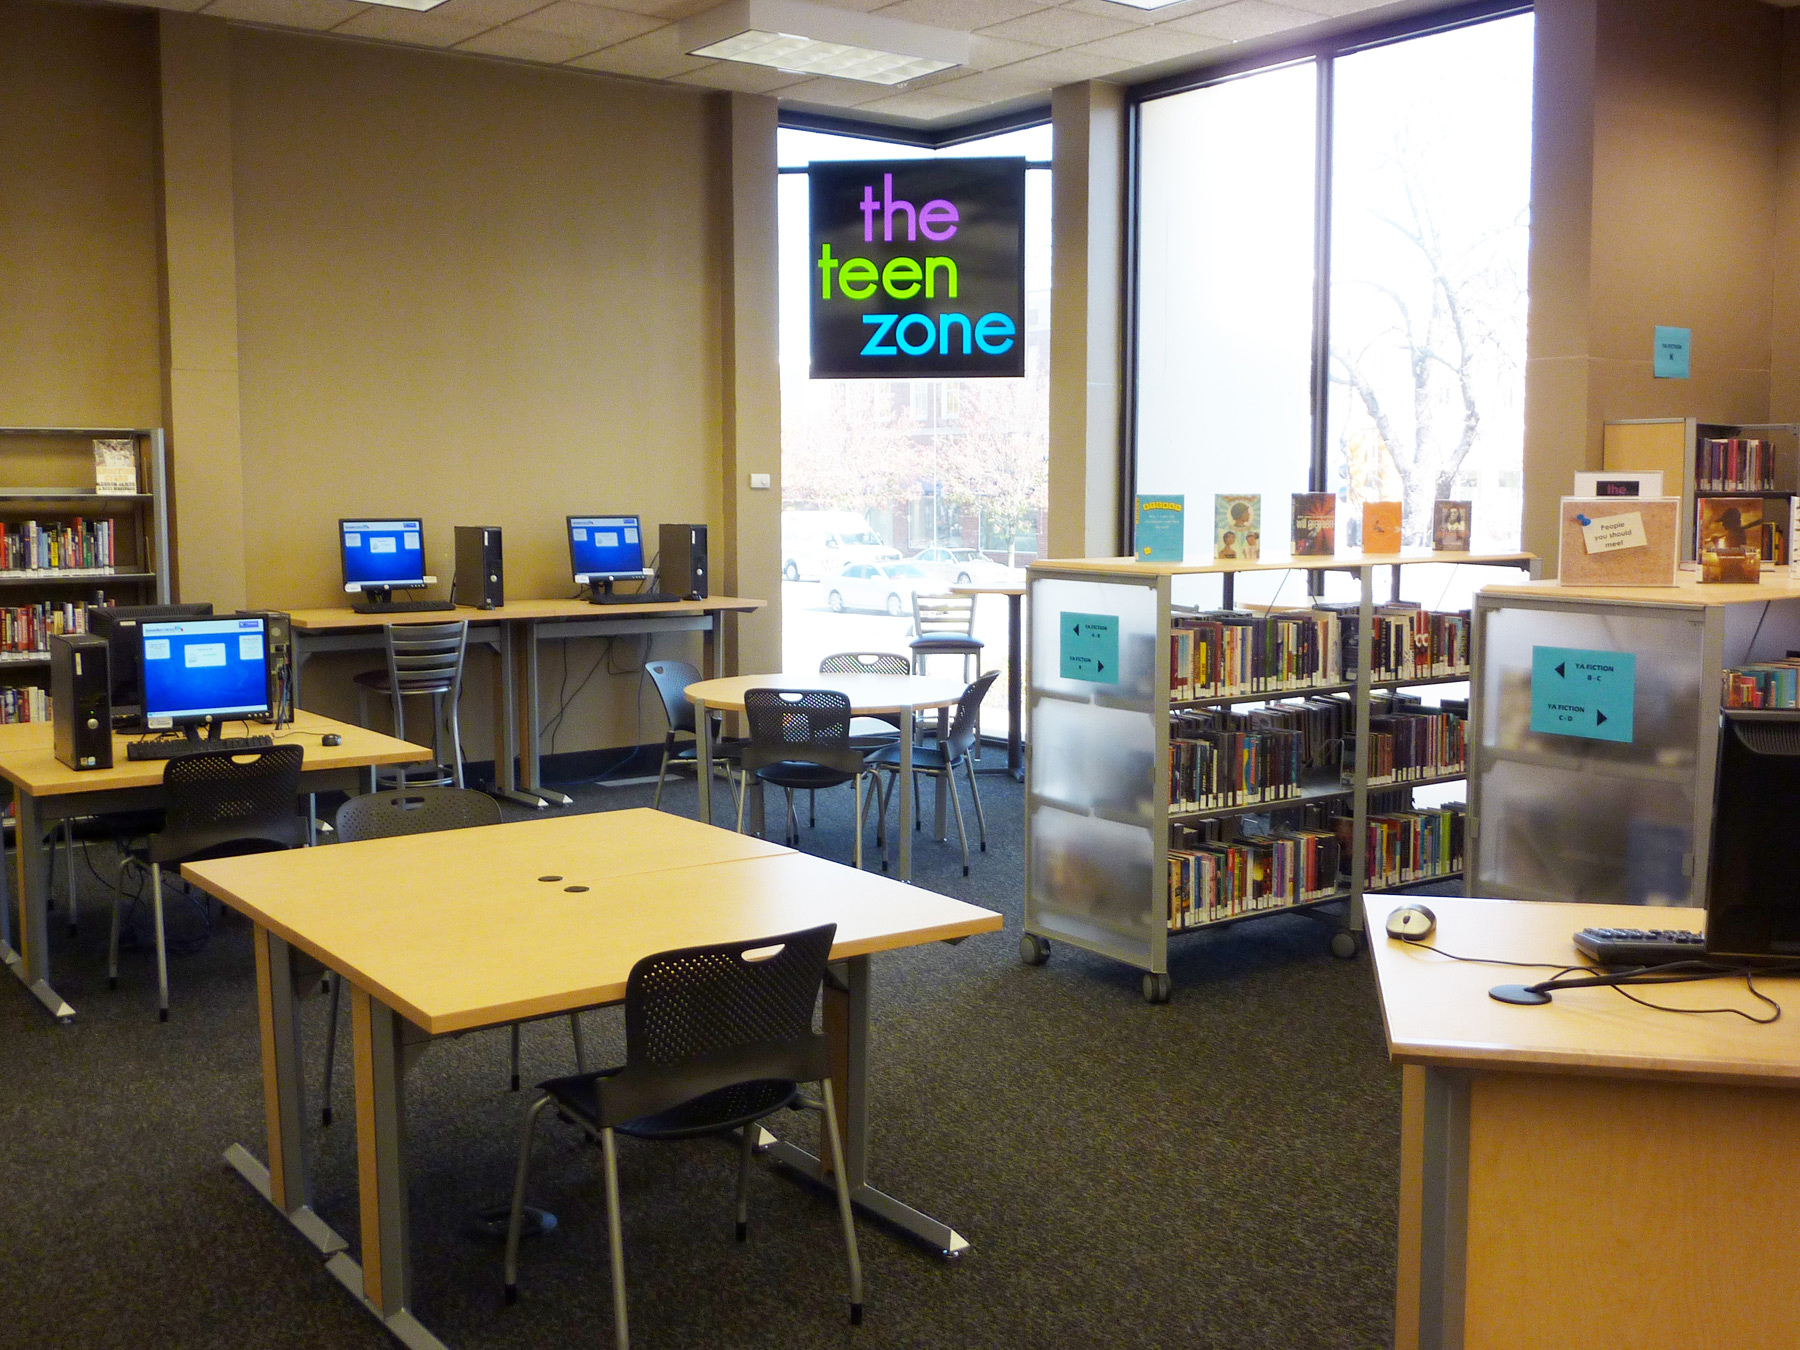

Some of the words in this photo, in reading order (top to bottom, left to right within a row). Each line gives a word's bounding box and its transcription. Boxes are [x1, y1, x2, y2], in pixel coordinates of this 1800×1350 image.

[859, 173, 960, 243] the
[818, 243, 958, 300] teen
[860, 312, 1016, 355] zone
[1608, 484, 1627, 495] the
[1601, 522, 1625, 531] People
[1609, 530, 1632, 538] should
[1586, 664, 1614, 672] FICTION
